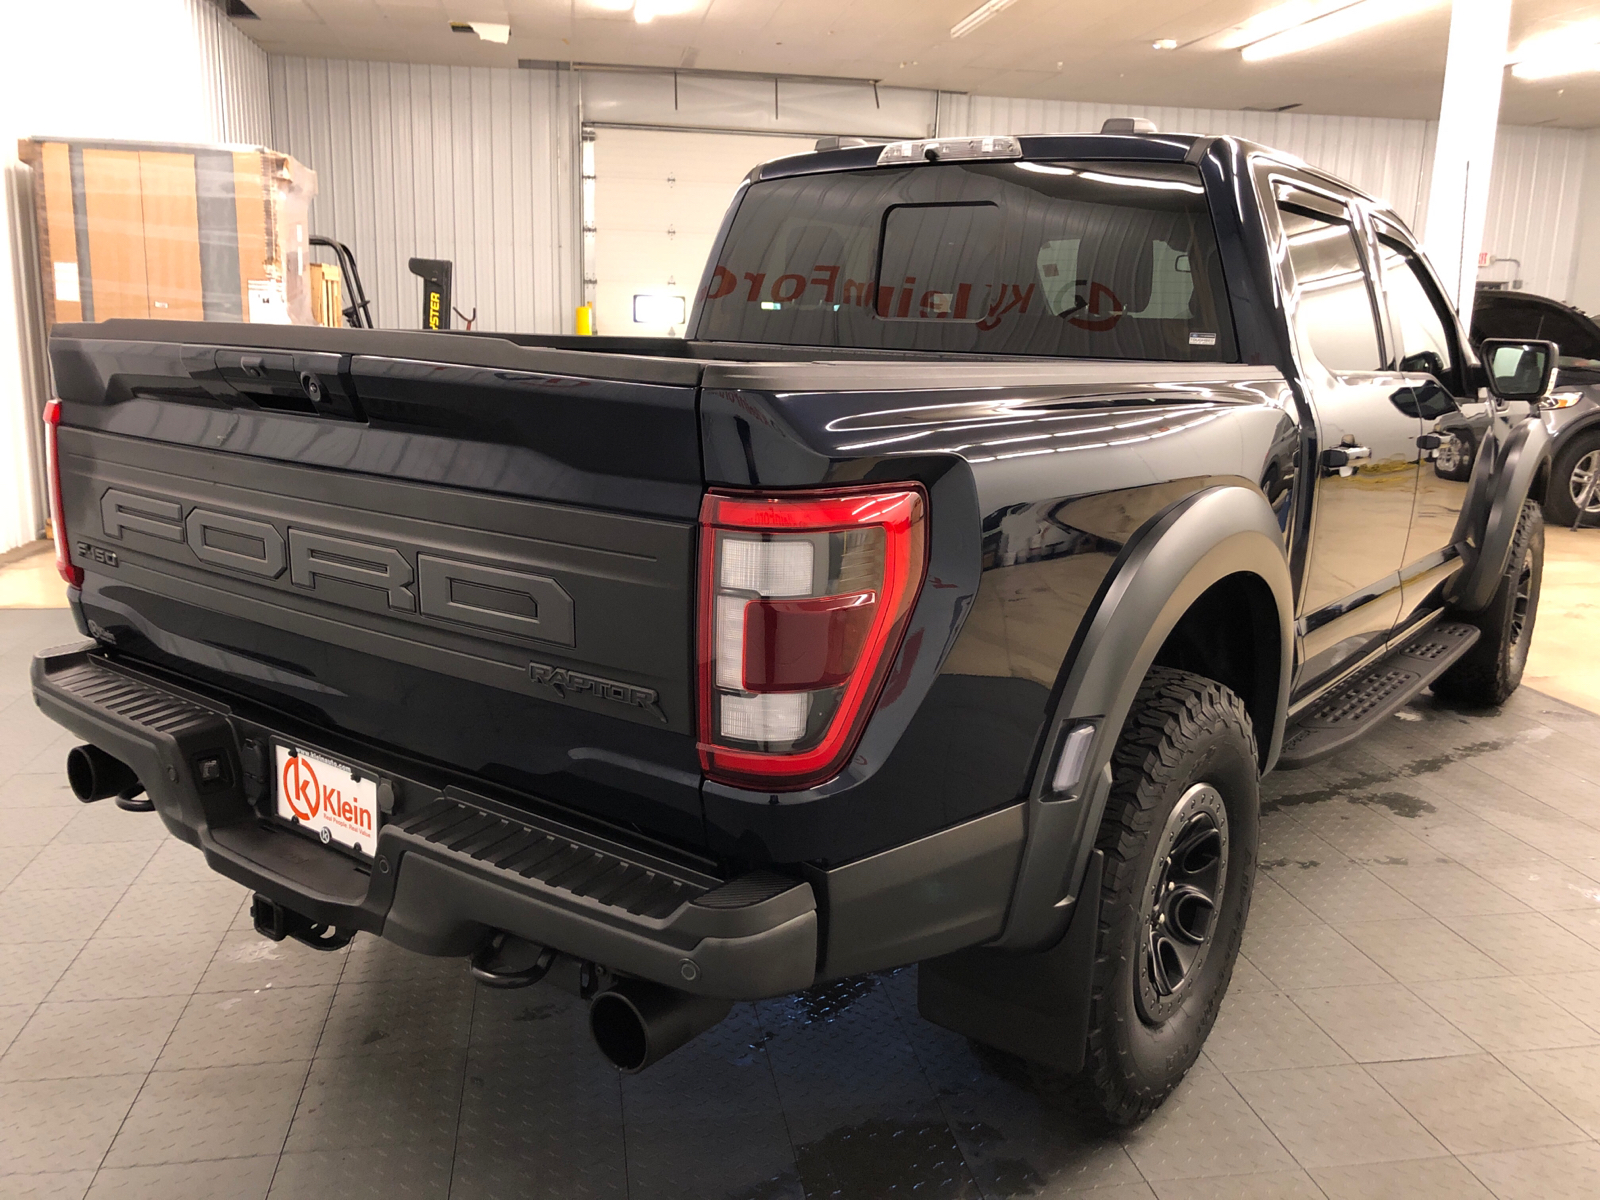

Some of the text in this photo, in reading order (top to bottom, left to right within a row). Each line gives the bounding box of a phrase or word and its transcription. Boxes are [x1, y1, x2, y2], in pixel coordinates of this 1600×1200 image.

[429, 291, 441, 331] YSTER
[100, 486, 577, 649] FORD
[529, 660, 669, 724] RAPTOR
[323, 784, 372, 830] Klein
